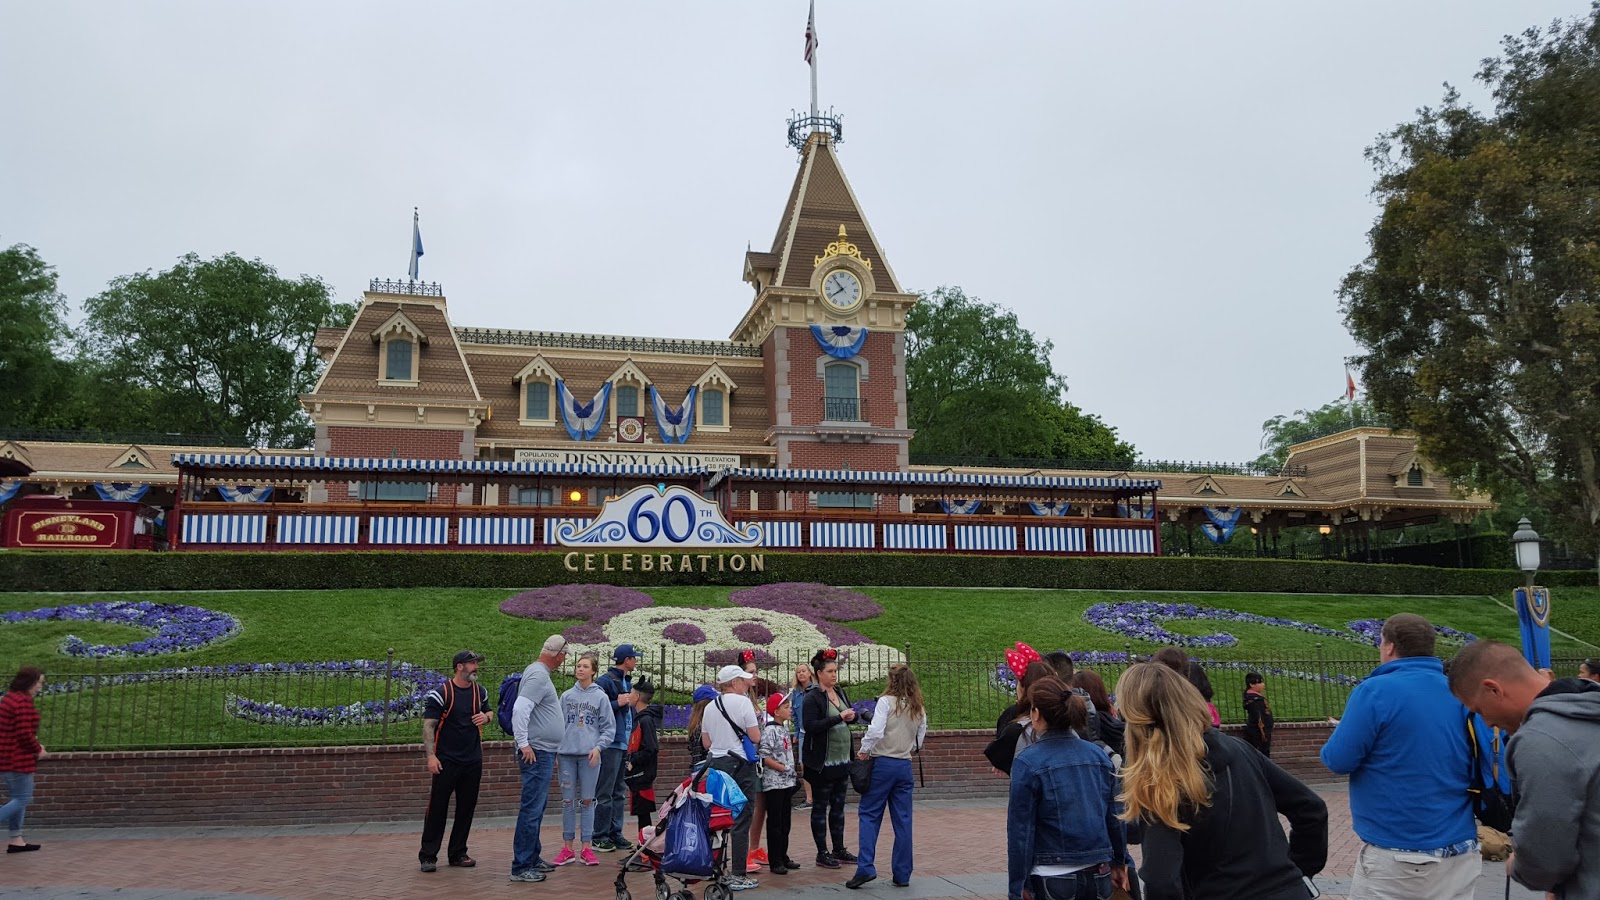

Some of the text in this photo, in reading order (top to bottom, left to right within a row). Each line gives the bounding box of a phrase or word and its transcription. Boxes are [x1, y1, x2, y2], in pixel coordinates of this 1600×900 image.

[564, 453, 701, 467] DISNEYLAND
[32, 515, 105, 532] DISNEYLAND
[37, 534, 97, 543] RAILROAD
[563, 552, 765, 573] CELEBRATION
